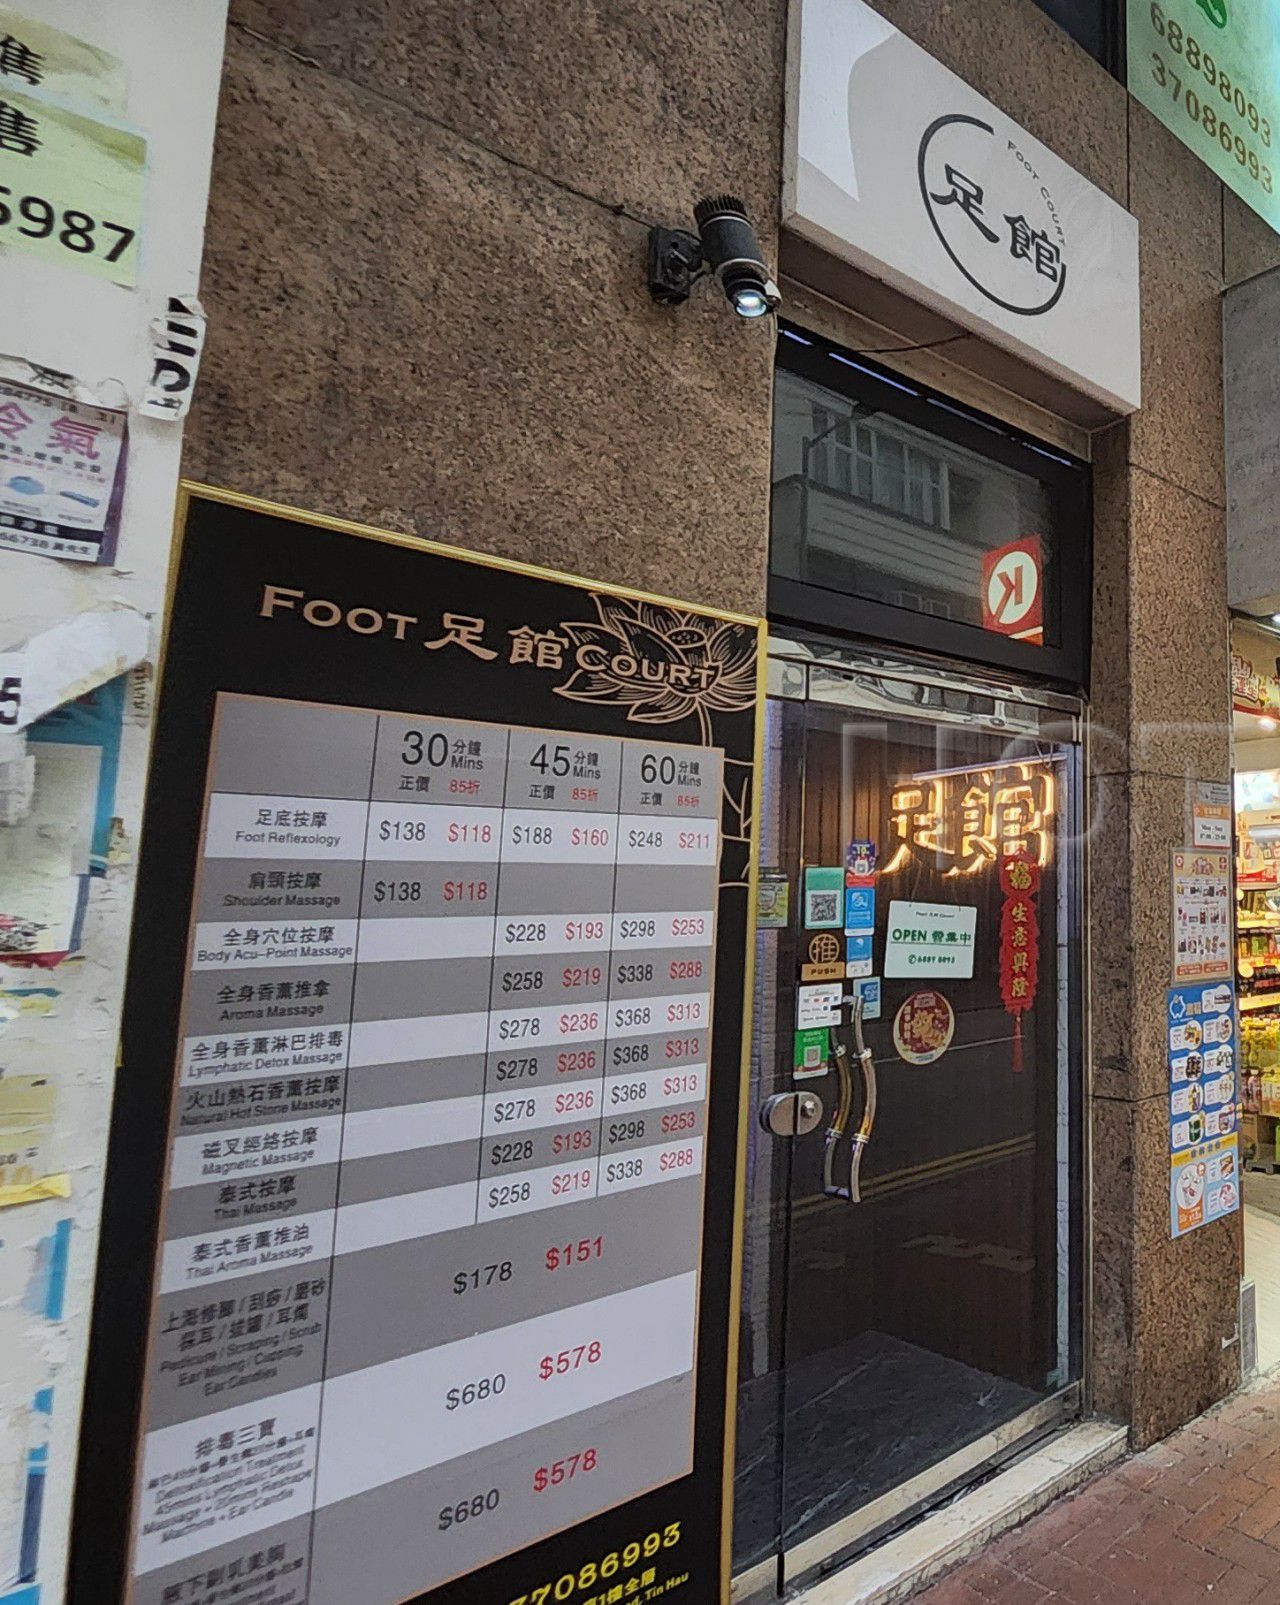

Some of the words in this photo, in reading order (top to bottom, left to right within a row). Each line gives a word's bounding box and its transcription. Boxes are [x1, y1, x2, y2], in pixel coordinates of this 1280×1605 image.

[1150, 4, 1271, 148] 68898093
[1152, 53, 1273, 194] 37086993
[1007, 140, 1040, 180] FOOT
[1040, 187, 1066, 246] COURT
[929, 162, 1061, 283] 足館
[259, 585, 417, 640] FOOT
[424, 612, 570, 670] 足館
[575, 643, 716, 690] COURT
[401, 730, 448, 767] 30
[451, 755, 483, 771] Mins
[530, 744, 570, 777] 45
[399, 776, 430, 793] 正價
[573, 765, 601, 781] Mins
[641, 754, 676, 785] 60
[677, 773, 702, 788] Mins
[529, 784, 555, 800] 正價
[256, 809, 329, 829] 足底按摩
[236, 831, 265, 843] Foot
[268, 832, 341, 848] Reflexology
[379, 820, 426, 842] $138
[448, 823, 491, 844] $118
[512, 826, 553, 845] $188
[571, 828, 609, 847] $160
[628, 830, 663, 849] $248
[679, 832, 710, 850] $211
[223, 894, 282, 907] Shoulder
[285, 894, 341, 908] Massage
[374, 881, 422, 902] $138
[443, 881, 488, 902] $118
[223, 926, 335, 947] 全身穴位按摩
[505, 923, 546, 944] $228
[565, 921, 604, 941] $193
[620, 920, 655, 939] $298
[671, 918, 704, 937] $253
[892, 928, 927, 942] OPEN
[197, 949, 230, 963] Body
[301, 945, 353, 959] Massage
[1011, 902, 1031, 997] 生意興隆
[502, 971, 543, 993] $258
[562, 968, 601, 988] $219
[617, 964, 653, 984] $338
[670, 960, 703, 980] $288
[220, 1008, 263, 1021] Aroma
[266, 1004, 324, 1018] Massage
[499, 1018, 540, 1040] $278
[560, 1013, 599, 1033] $236
[615, 1007, 651, 1028] $368
[667, 1002, 701, 1022] $313
[255, 1056, 289, 1070] Detox
[292, 1051, 342, 1066] Massage
[496, 1057, 538, 1081] $278
[557, 1051, 596, 1073] $236
[613, 1044, 649, 1066] $368
[665, 1038, 699, 1059] $313
[291, 1097, 341, 1112] Massage
[493, 1099, 536, 1123] $278
[555, 1090, 594, 1113] $236
[611, 1082, 647, 1104] $368
[663, 1074, 697, 1095] $313
[491, 1140, 533, 1165] $228
[553, 1130, 592, 1154] $193
[608, 1120, 645, 1144] $298
[661, 1111, 695, 1133] $253
[202, 1157, 259, 1175] Magnetic
[262, 1150, 315, 1166] Massage
[488, 1182, 531, 1208] $258
[552, 1170, 591, 1195] $219
[606, 1159, 643, 1183] $338
[659, 1149, 693, 1171] $288
[243, 1198, 298, 1214] Massage
[259, 1245, 313, 1263] Massage
[453, 1260, 513, 1295] $178
[545, 1236, 604, 1271] $151
[445, 1373, 506, 1411] $680
[539, 1341, 602, 1381] $578
[438, 1488, 500, 1531] $680
[533, 1449, 597, 1492] $578
[645, 1585, 664, 1601] Tin
[666, 1571, 690, 1591] Hau
